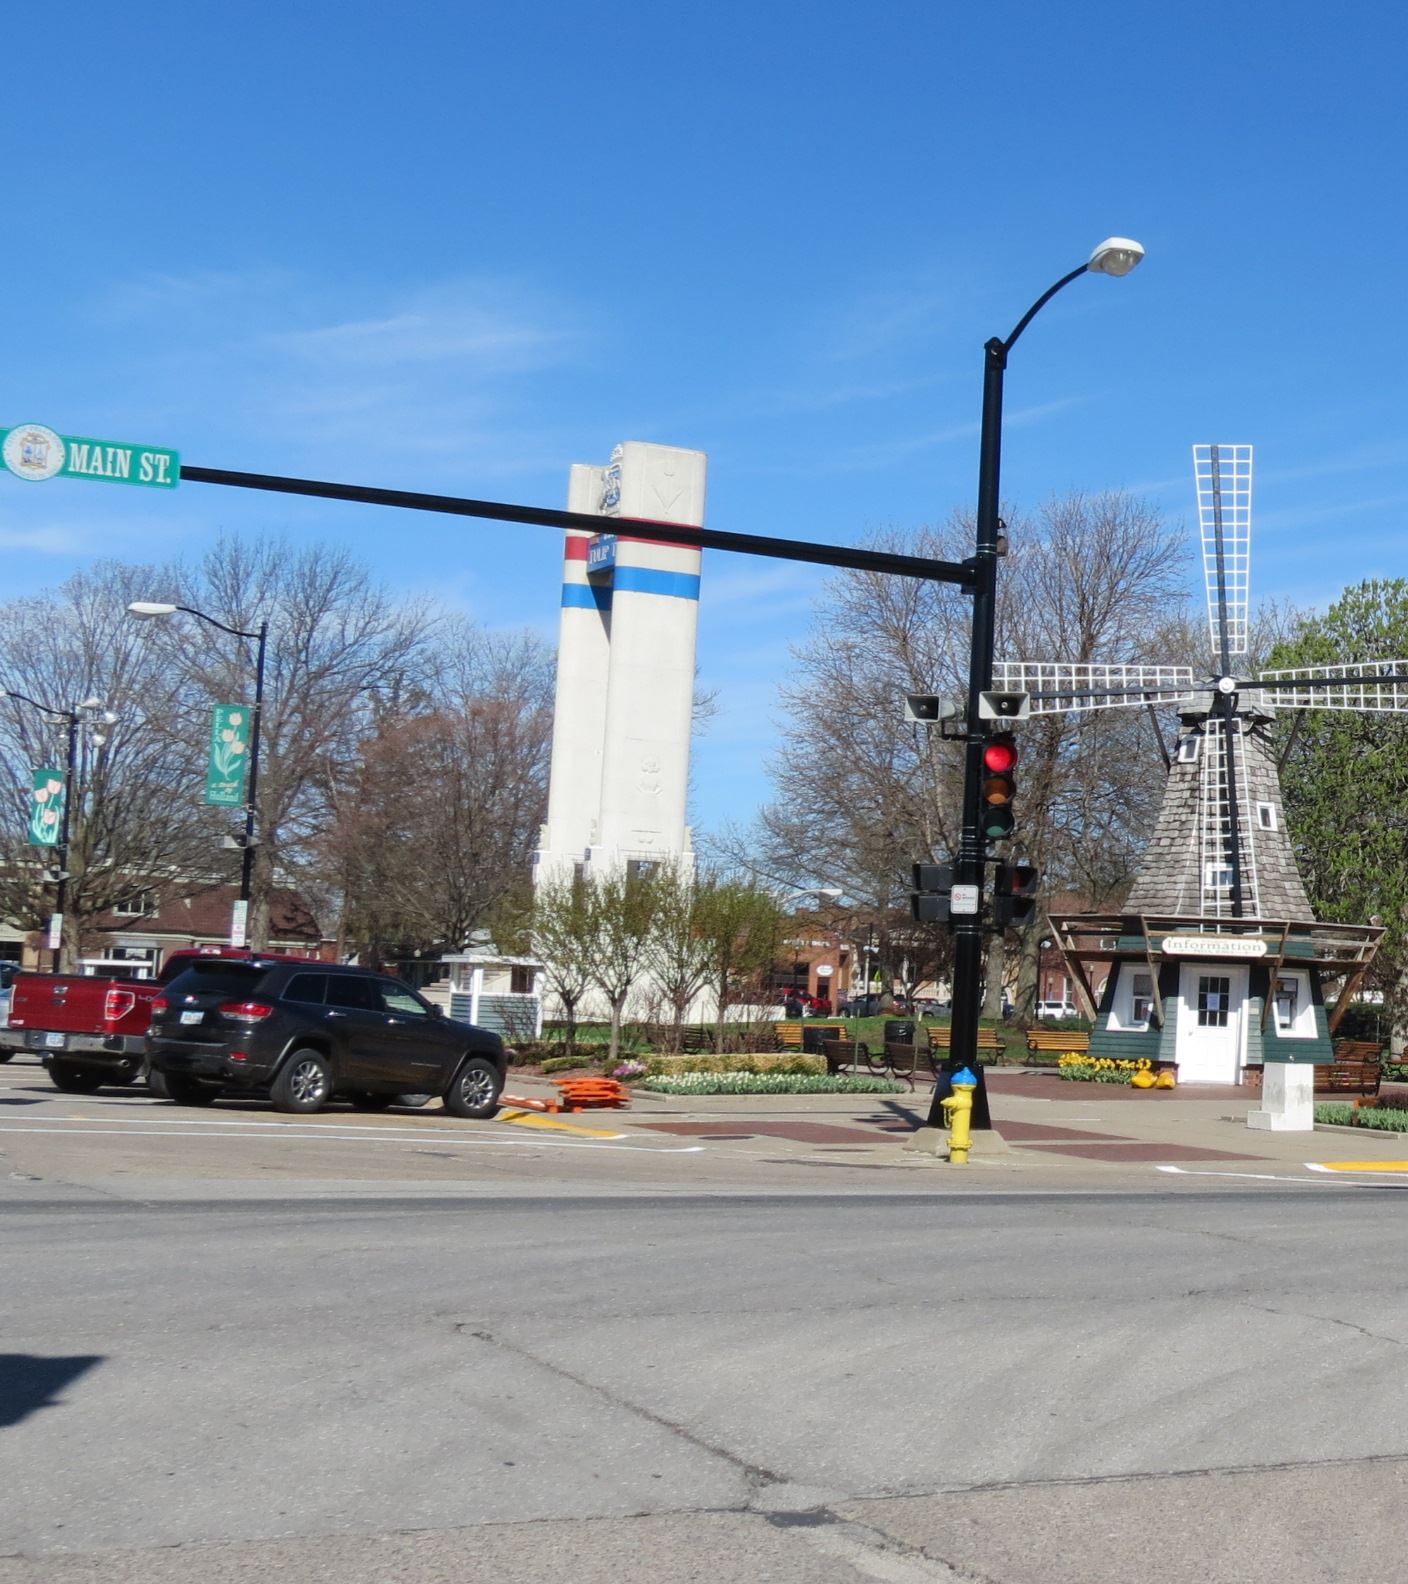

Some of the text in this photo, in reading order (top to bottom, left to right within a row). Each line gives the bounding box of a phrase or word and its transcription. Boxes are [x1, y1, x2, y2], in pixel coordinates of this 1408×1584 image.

[68, 443, 132, 478] MAIN
[139, 452, 171, 484] ST.
[1167, 938, 1262, 951] Information
